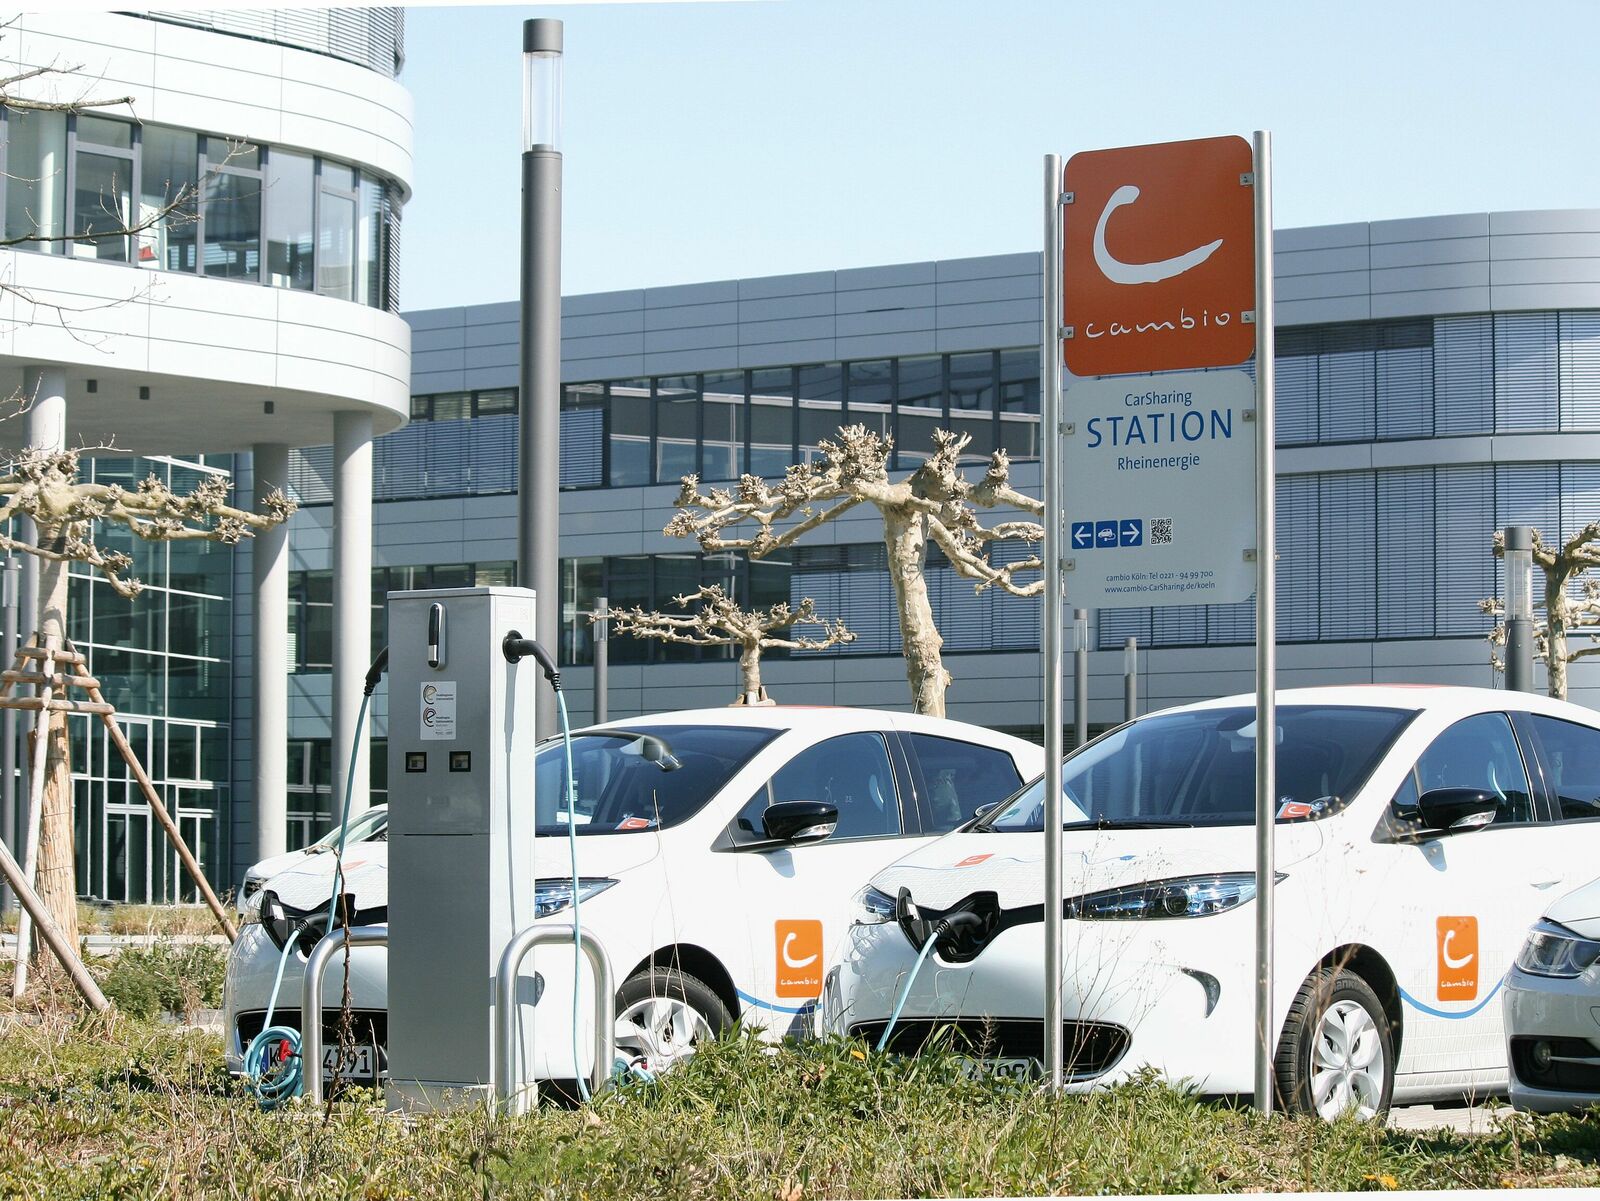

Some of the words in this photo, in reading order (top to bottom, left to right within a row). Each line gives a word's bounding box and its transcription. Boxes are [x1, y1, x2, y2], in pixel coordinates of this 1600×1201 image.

[1085, 308, 1231, 338] cambio
[1124, 390, 1193, 407] CarSharing
[1087, 408, 1232, 448] STATION
[1117, 453, 1200, 471] Rheinenergie
[1159, 572, 1174, 580] 0221
[1179, 572, 1189, 580] 94
[1189, 571, 1199, 580] 99
[1200, 570, 1214, 579] 700
[781, 976, 818, 985] cambio
[1441, 978, 1474, 987] cambio
